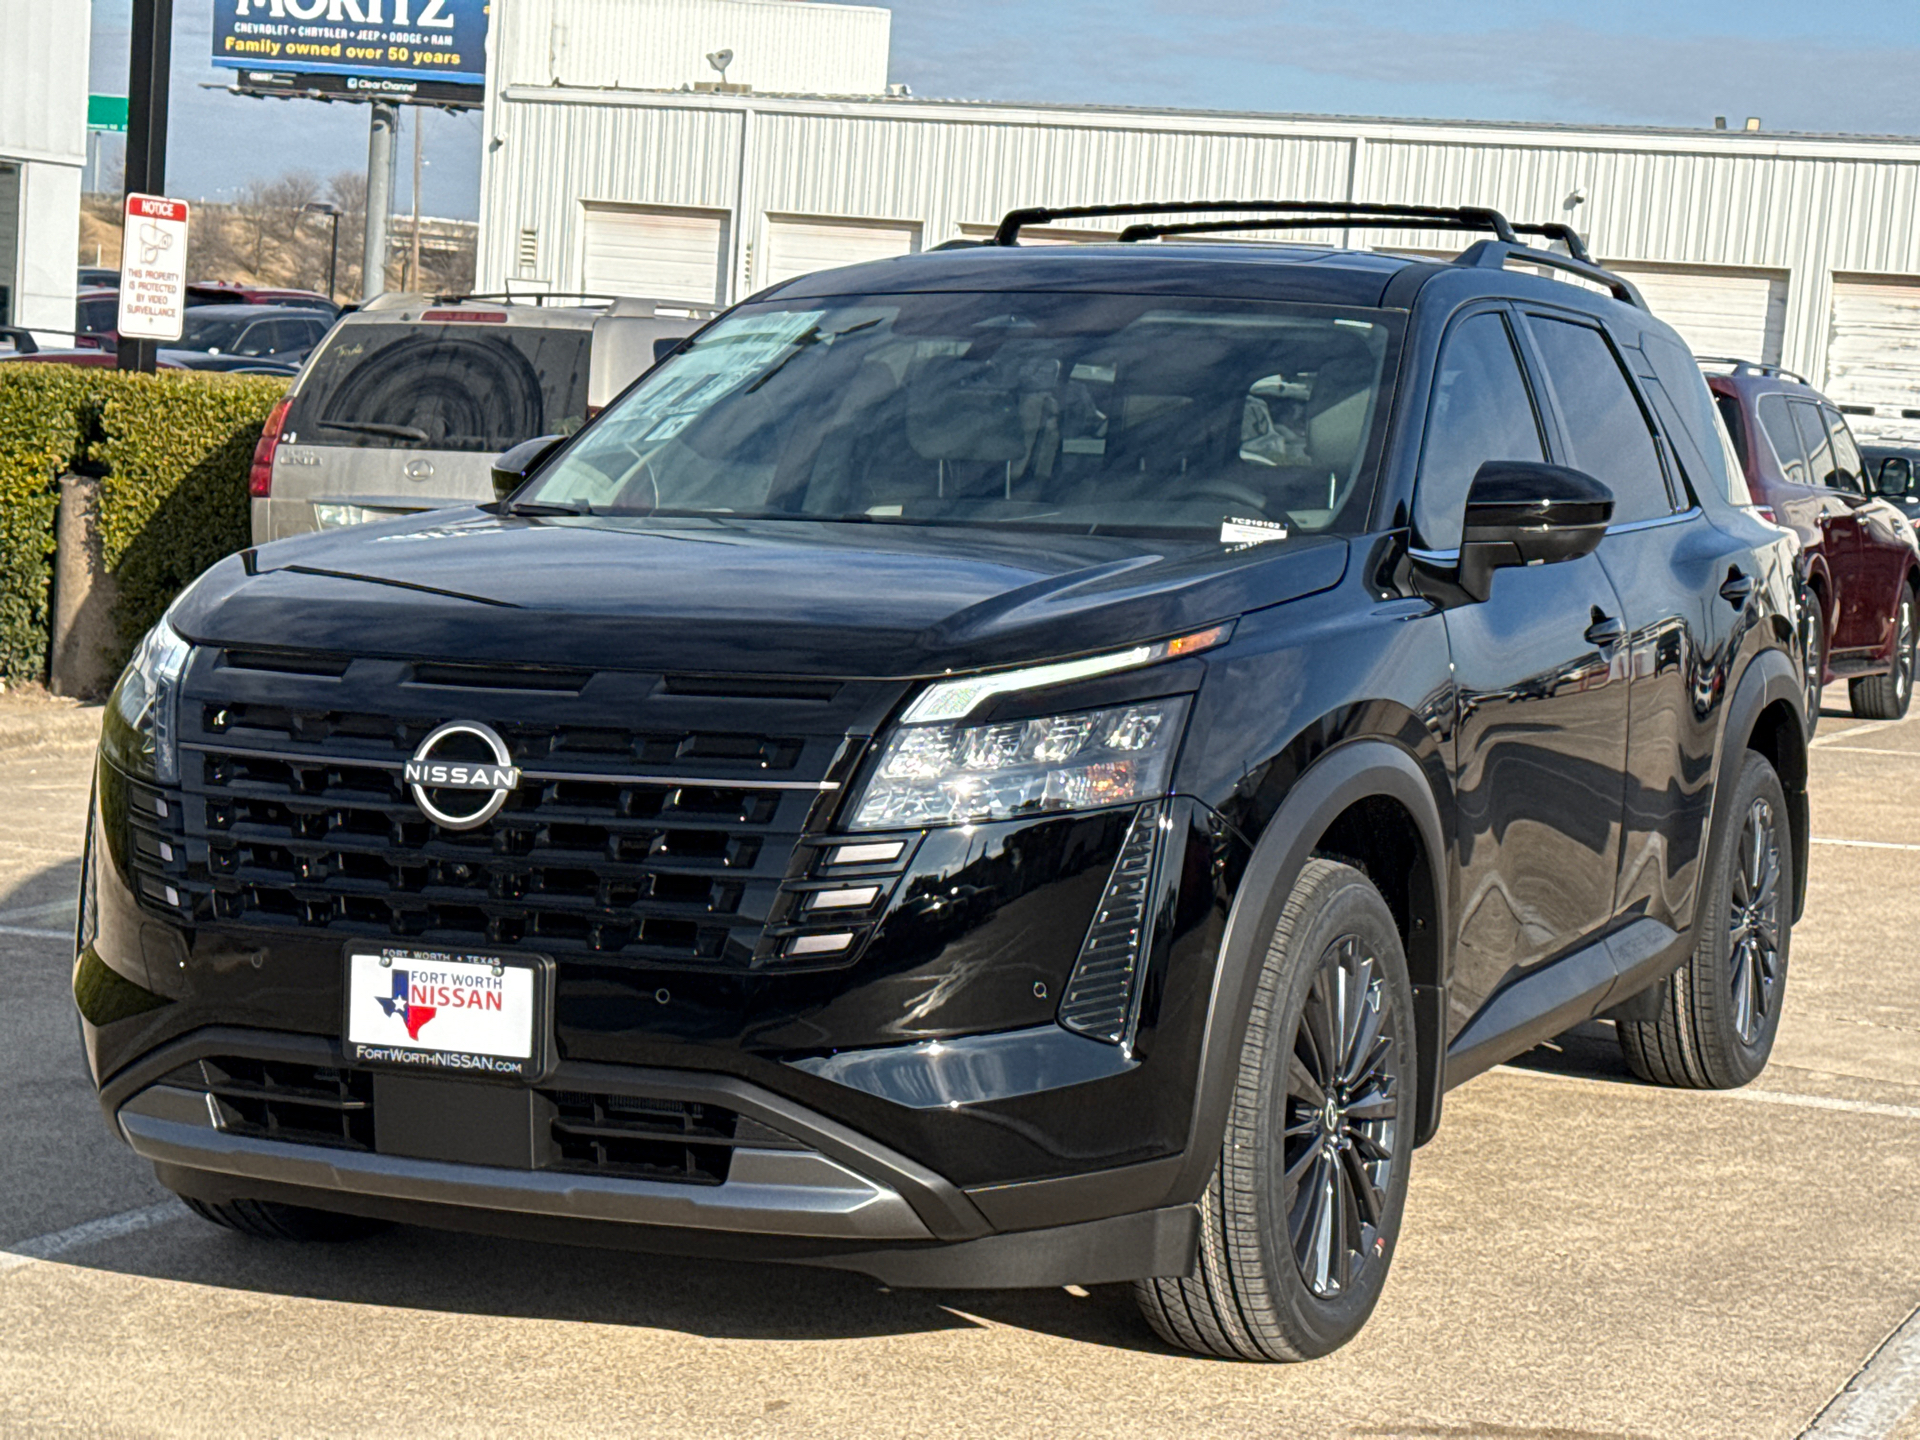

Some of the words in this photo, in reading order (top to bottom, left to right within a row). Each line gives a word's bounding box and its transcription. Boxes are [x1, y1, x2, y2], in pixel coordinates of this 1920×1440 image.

[234, 21, 289, 35] CHEVROLET
[298, 25, 348, 39] CHRYSLER
[356, 29, 380, 41] JEEP
[389, 31, 422, 45] DODGE
[431, 34, 453, 46] RAM
[225, 36, 281, 56] Family
[286, 42, 341, 57] owned
[346, 46, 384, 59] over
[388, 46, 409, 61] 50
[413, 51, 461, 65] years
[358, 79, 382, 89] Clear
[382, 80, 418, 92] Channel
[141, 200, 174, 216] NOTICE
[128, 268, 142, 279] THIS
[145, 270, 179, 281] PROPERTY
[129, 281, 135, 290] IS
[138, 282, 177, 294] PROTECTED
[136, 293, 145, 302] BY
[148, 294, 168, 305] VIDEO
[127, 304, 176, 318] SURVEILLANCE
[405, 763, 514, 786] NISSAN
[383, 948, 409, 957] FORT
[413, 950, 450, 961] WORTH
[466, 955, 501, 966] TEXAS
[411, 970, 448, 984] FORT
[451, 973, 503, 989] WORTH
[411, 984, 503, 1012] NISSAN
